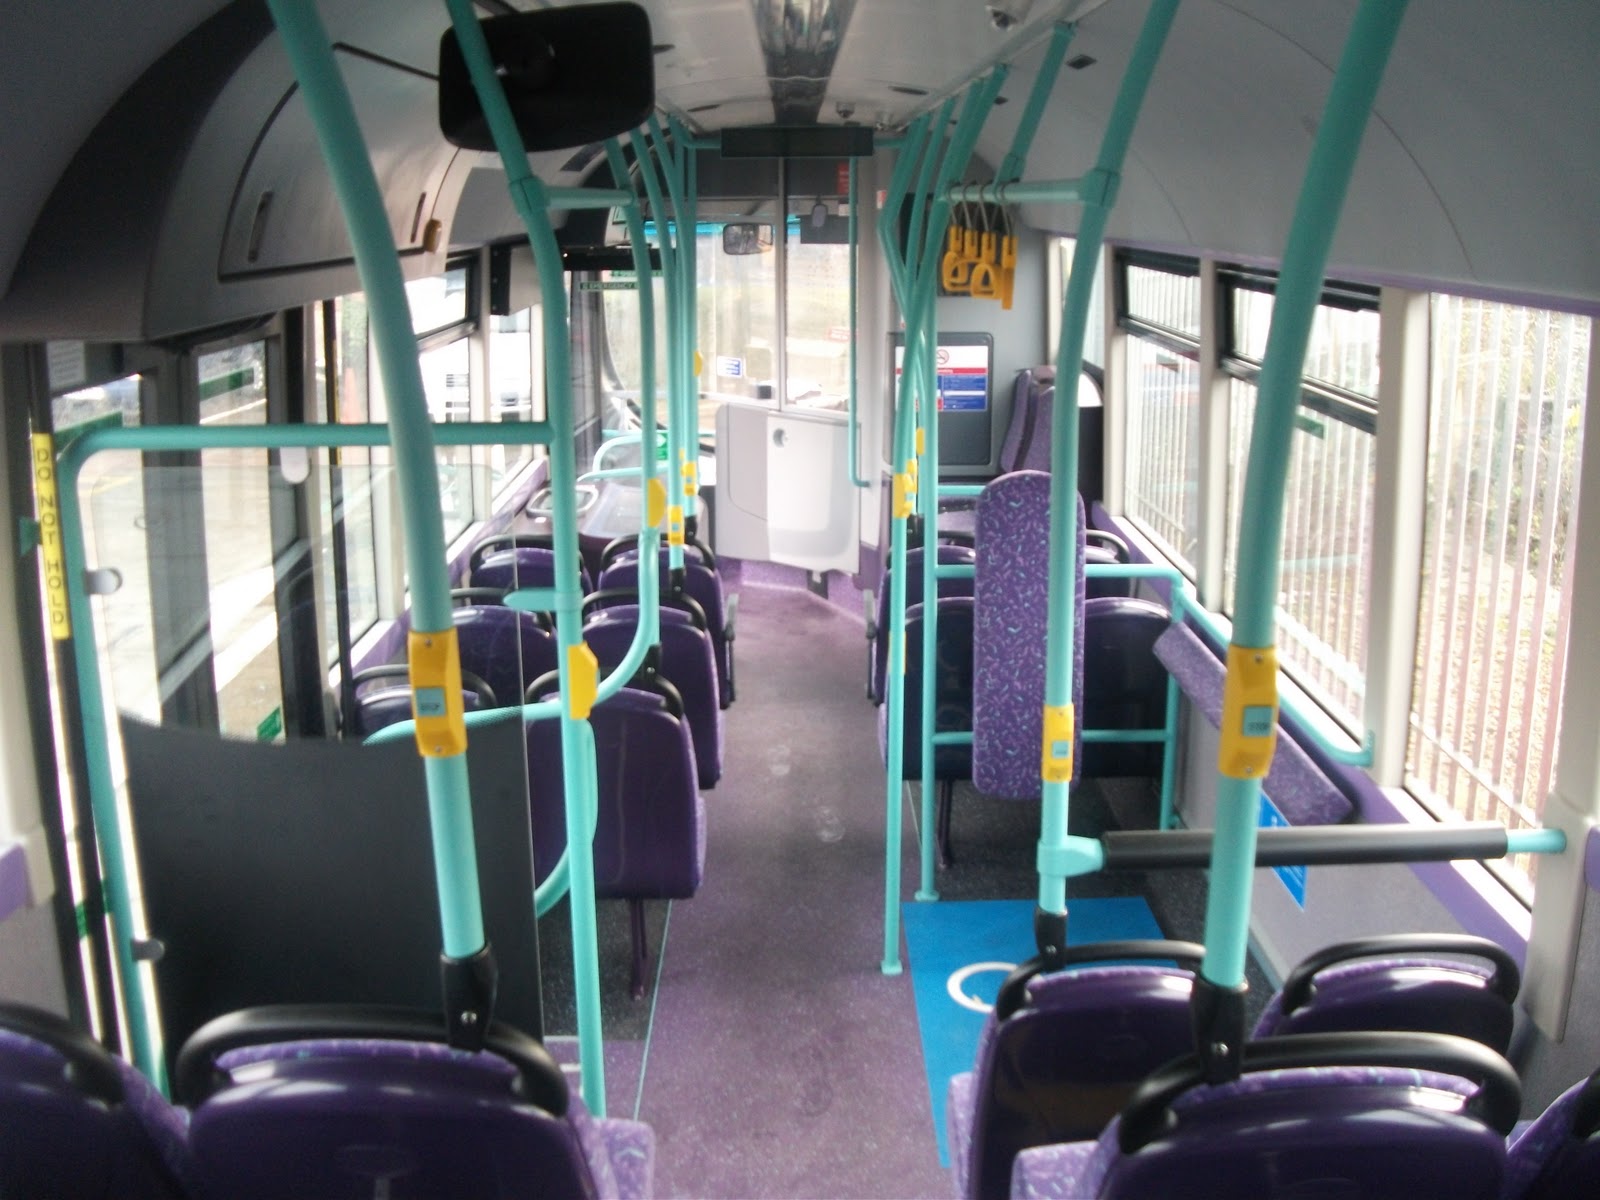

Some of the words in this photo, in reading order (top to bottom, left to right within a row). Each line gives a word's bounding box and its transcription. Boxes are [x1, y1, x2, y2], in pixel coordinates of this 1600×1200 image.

[36, 447, 51, 480] DO
[40, 494, 57, 545] NOT
[47, 559, 65, 624] HOLD
